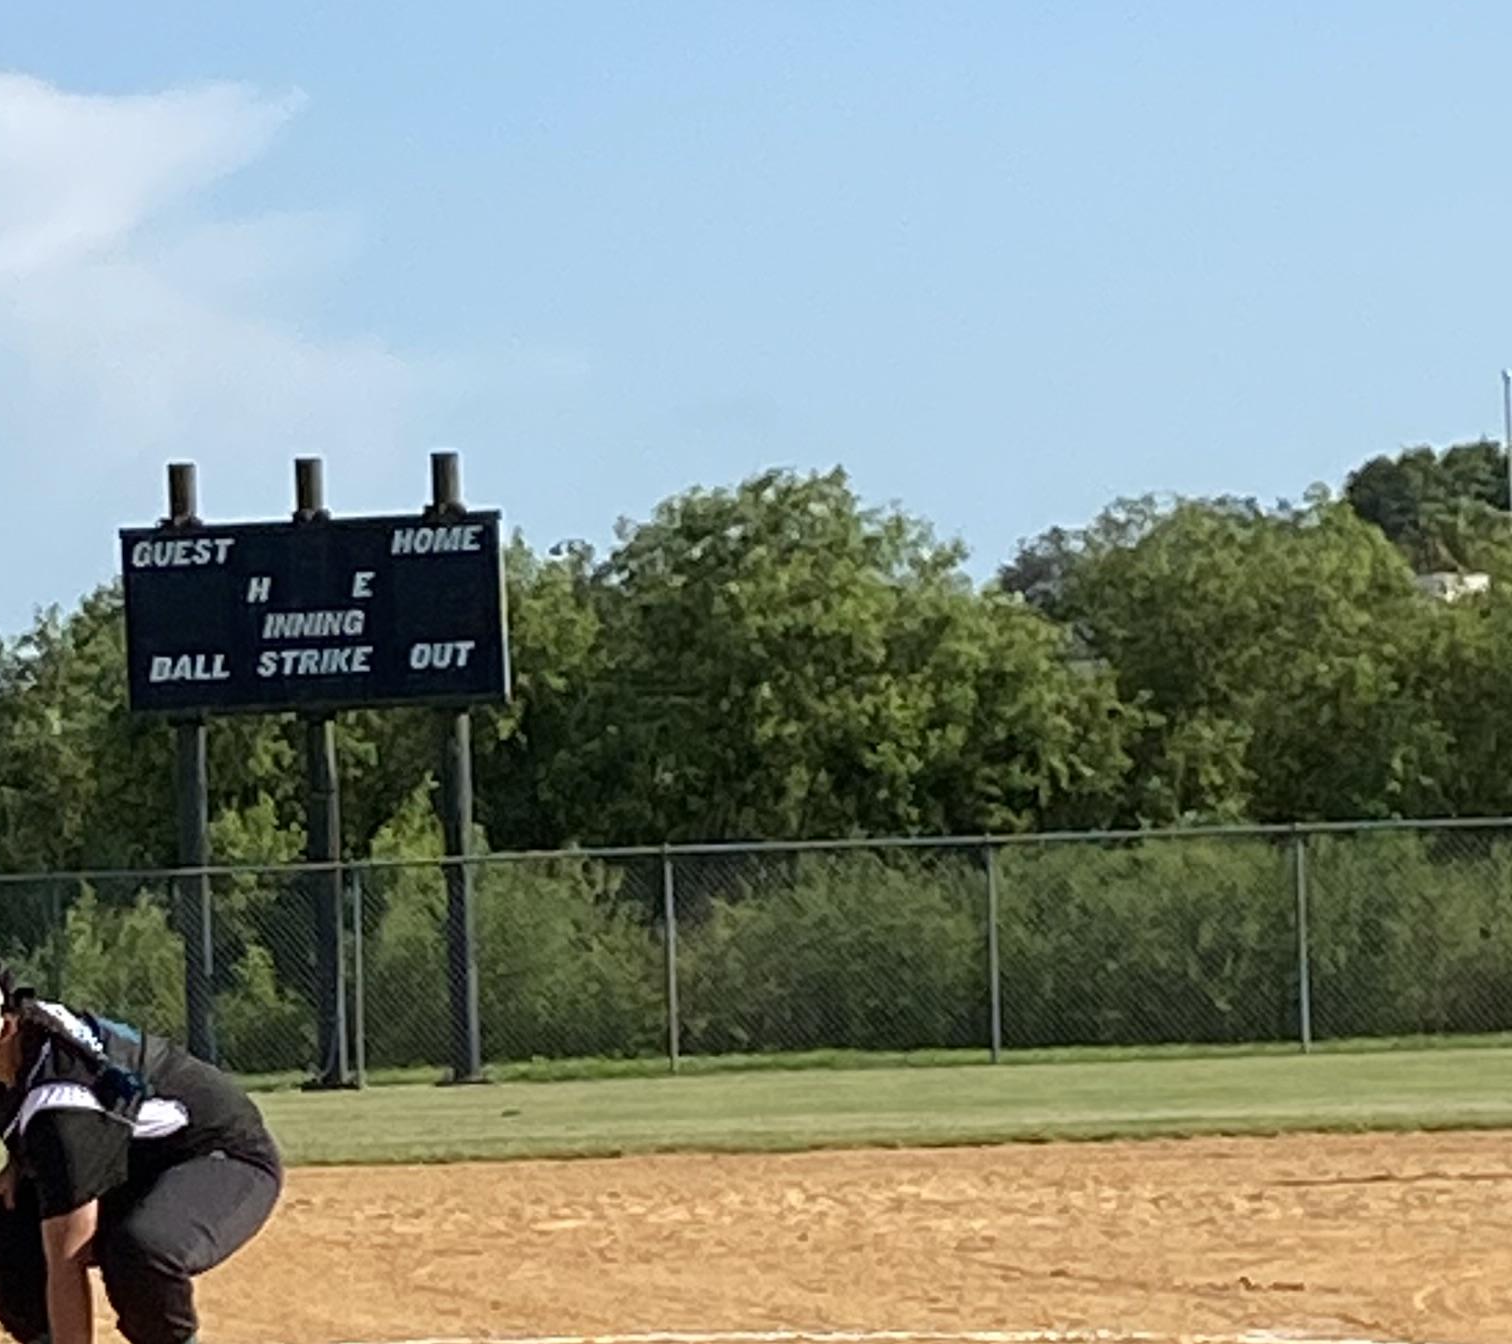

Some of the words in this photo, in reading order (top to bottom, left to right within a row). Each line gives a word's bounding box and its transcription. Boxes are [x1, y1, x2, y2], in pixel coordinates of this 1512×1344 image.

[131, 538, 234, 567] GUEST
[391, 525, 482, 554] HOME
[247, 577, 271, 602] H
[352, 571, 375, 597] E
[262, 610, 365, 638] INNING
[149, 654, 230, 682] BALL
[257, 647, 373, 676] STRIKE
[410, 641, 475, 669] OUT
